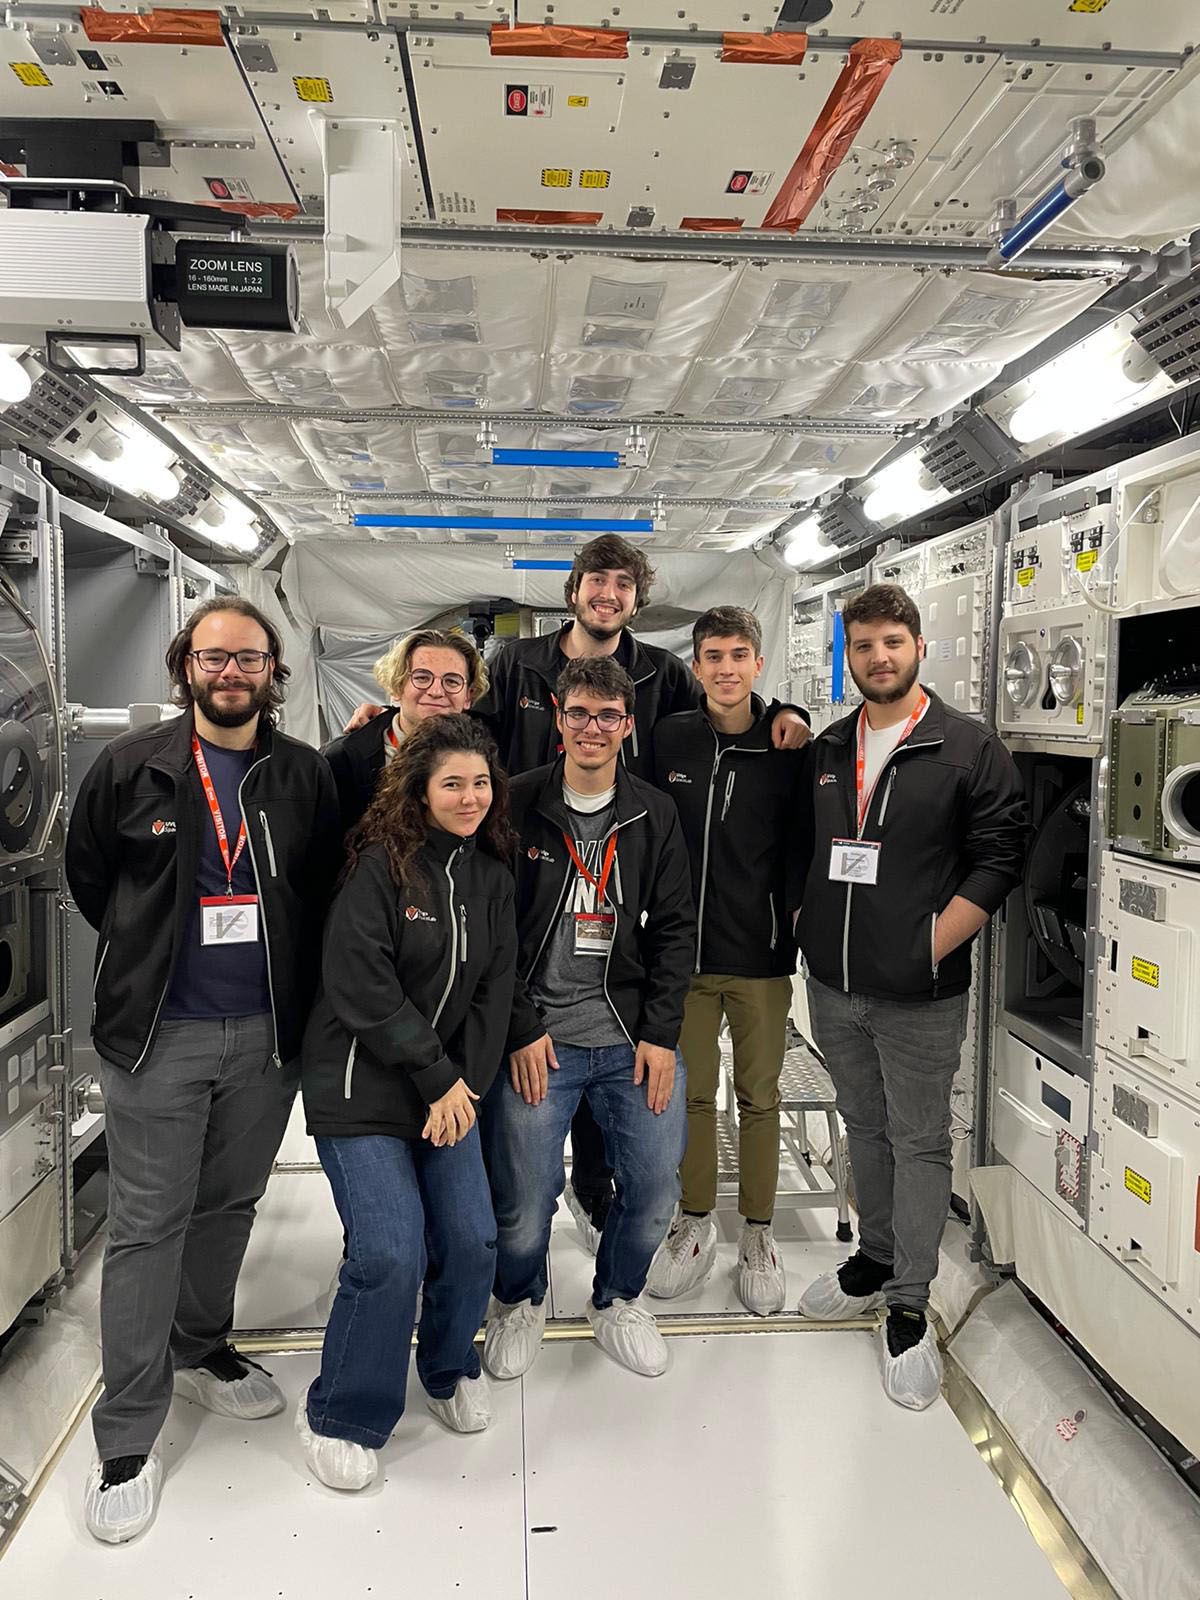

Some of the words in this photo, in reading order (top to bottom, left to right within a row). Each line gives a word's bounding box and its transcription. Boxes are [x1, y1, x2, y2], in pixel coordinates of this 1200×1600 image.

[190, 259, 227, 271] ZOOM
[230, 260, 263, 273] LENS
[188, 274, 197, 282] 16
[203, 275, 228, 283] 160mm
[187, 283, 207, 291] LENS
[208, 284, 230, 292] MADE
[240, 285, 263, 293] JAPAN
[195, 750, 209, 778] VISITOR
[213, 809, 227, 840] VISITOR
